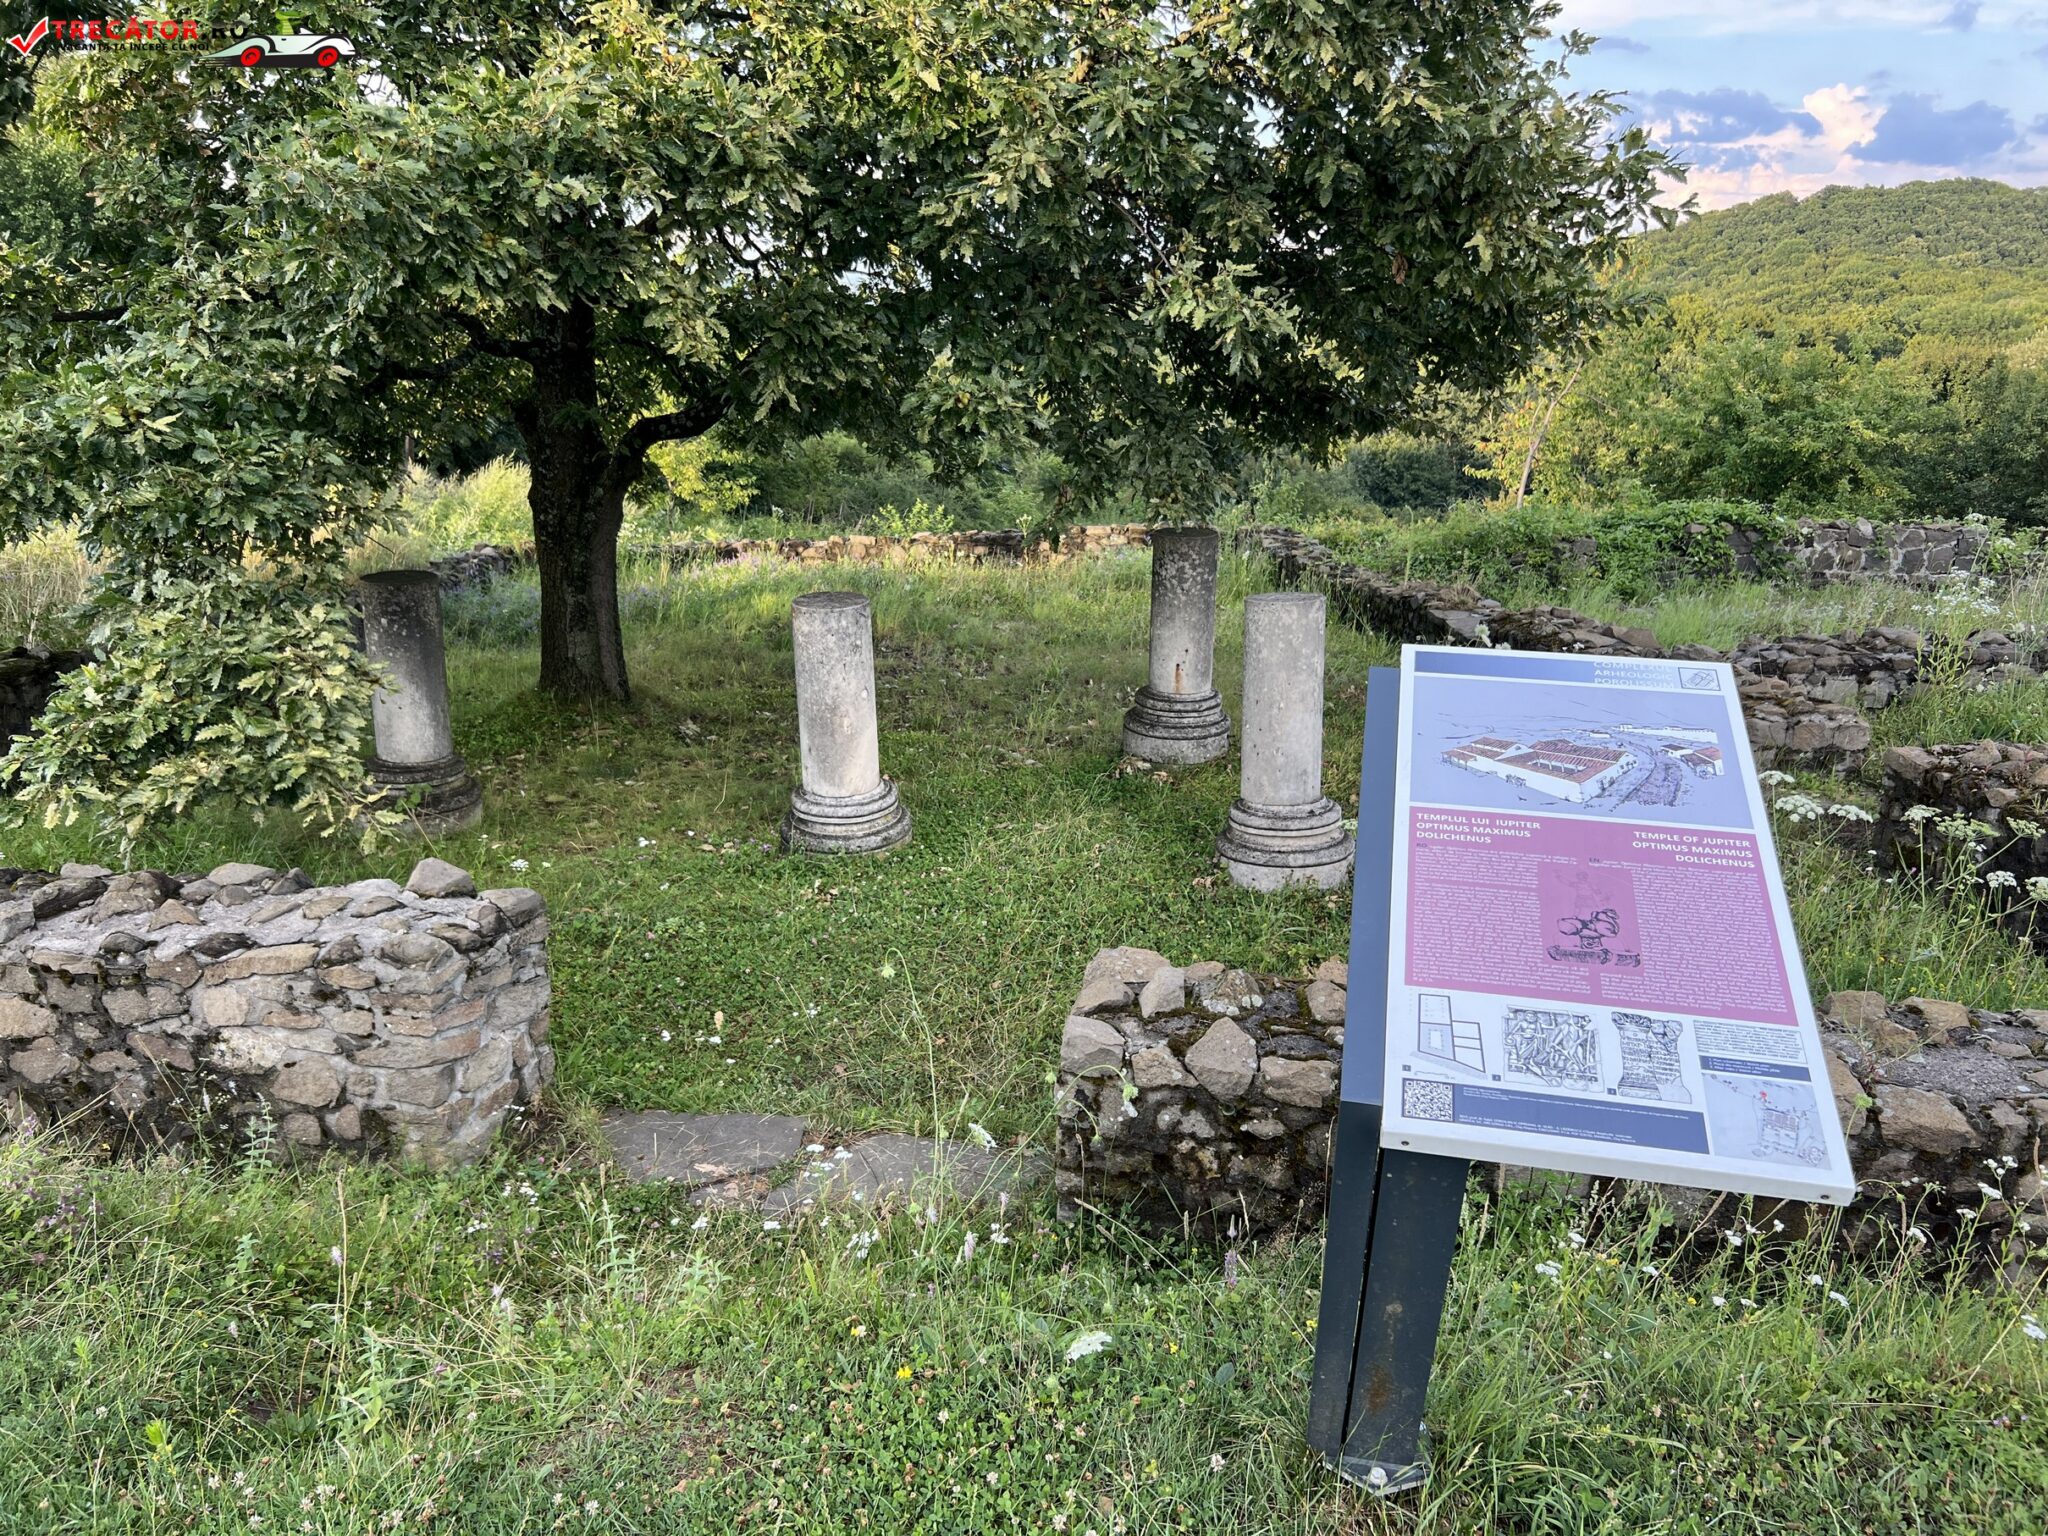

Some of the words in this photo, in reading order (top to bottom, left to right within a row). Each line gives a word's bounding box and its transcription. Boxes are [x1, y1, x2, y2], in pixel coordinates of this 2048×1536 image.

[1416, 813, 1468, 824] TEMPLUL
[1471, 817, 1489, 825] LUI
[1496, 819, 1541, 829] IUPITER
[1416, 822, 1470, 833] OPTIMUS
[1473, 827, 1531, 837] MAXIMUS
[1416, 831, 1491, 843] DOLICHENUS
[1633, 831, 1680, 842] TEMPLE
[1683, 835, 1699, 843] OF
[1702, 837, 1751, 848] JUPITER
[1632, 841, 1689, 852] OPTIMUS
[1691, 846, 1753, 858] MAXIMUS
[1675, 854, 1755, 868] DOLICHENUS
